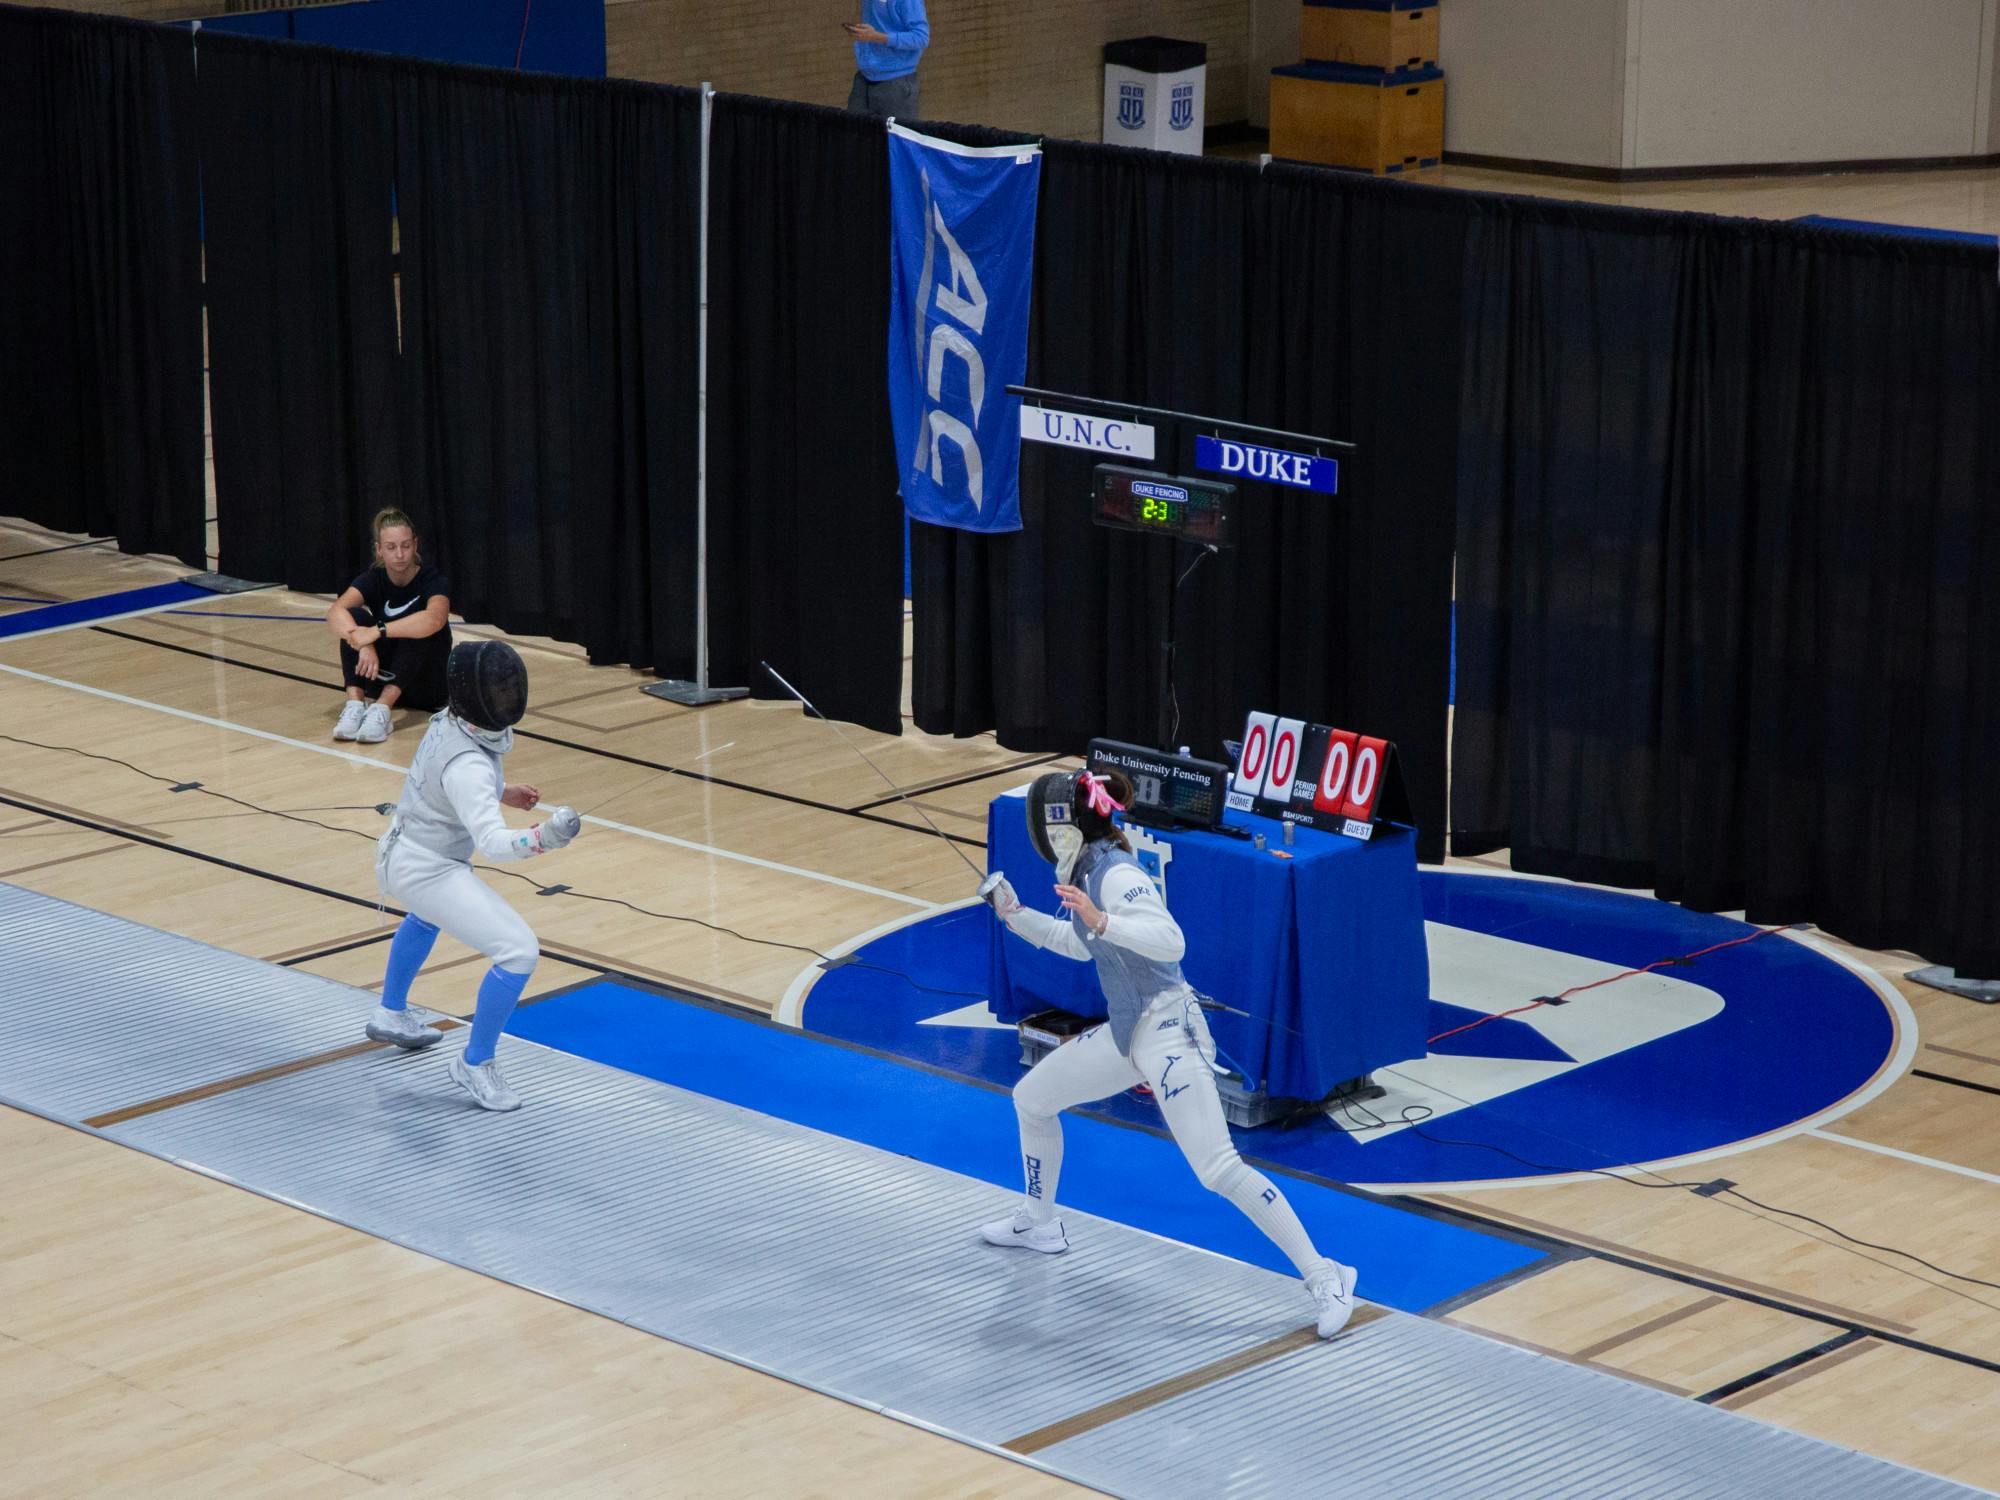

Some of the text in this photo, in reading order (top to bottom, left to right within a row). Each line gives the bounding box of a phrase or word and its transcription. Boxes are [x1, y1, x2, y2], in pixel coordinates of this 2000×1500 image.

[928, 200, 988, 515] ACC
[1043, 412, 1131, 451] U.N.C.
[1220, 442, 1311, 486] DUKE
[1135, 484, 1185, 500] DUKE FENCING
[1094, 750, 1212, 787] Duke University Fencing
[1293, 788, 1315, 800] GAMES
[1295, 780, 1317, 792] PERIOD
[1229, 795, 1250, 808] HOME
[1345, 824, 1370, 837] GUEST
[1124, 886, 1151, 902] DUKE
[1156, 1017, 1179, 1031] ACC
[1026, 1154, 1042, 1200] DUKE
[1260, 1188, 1277, 1205] D
